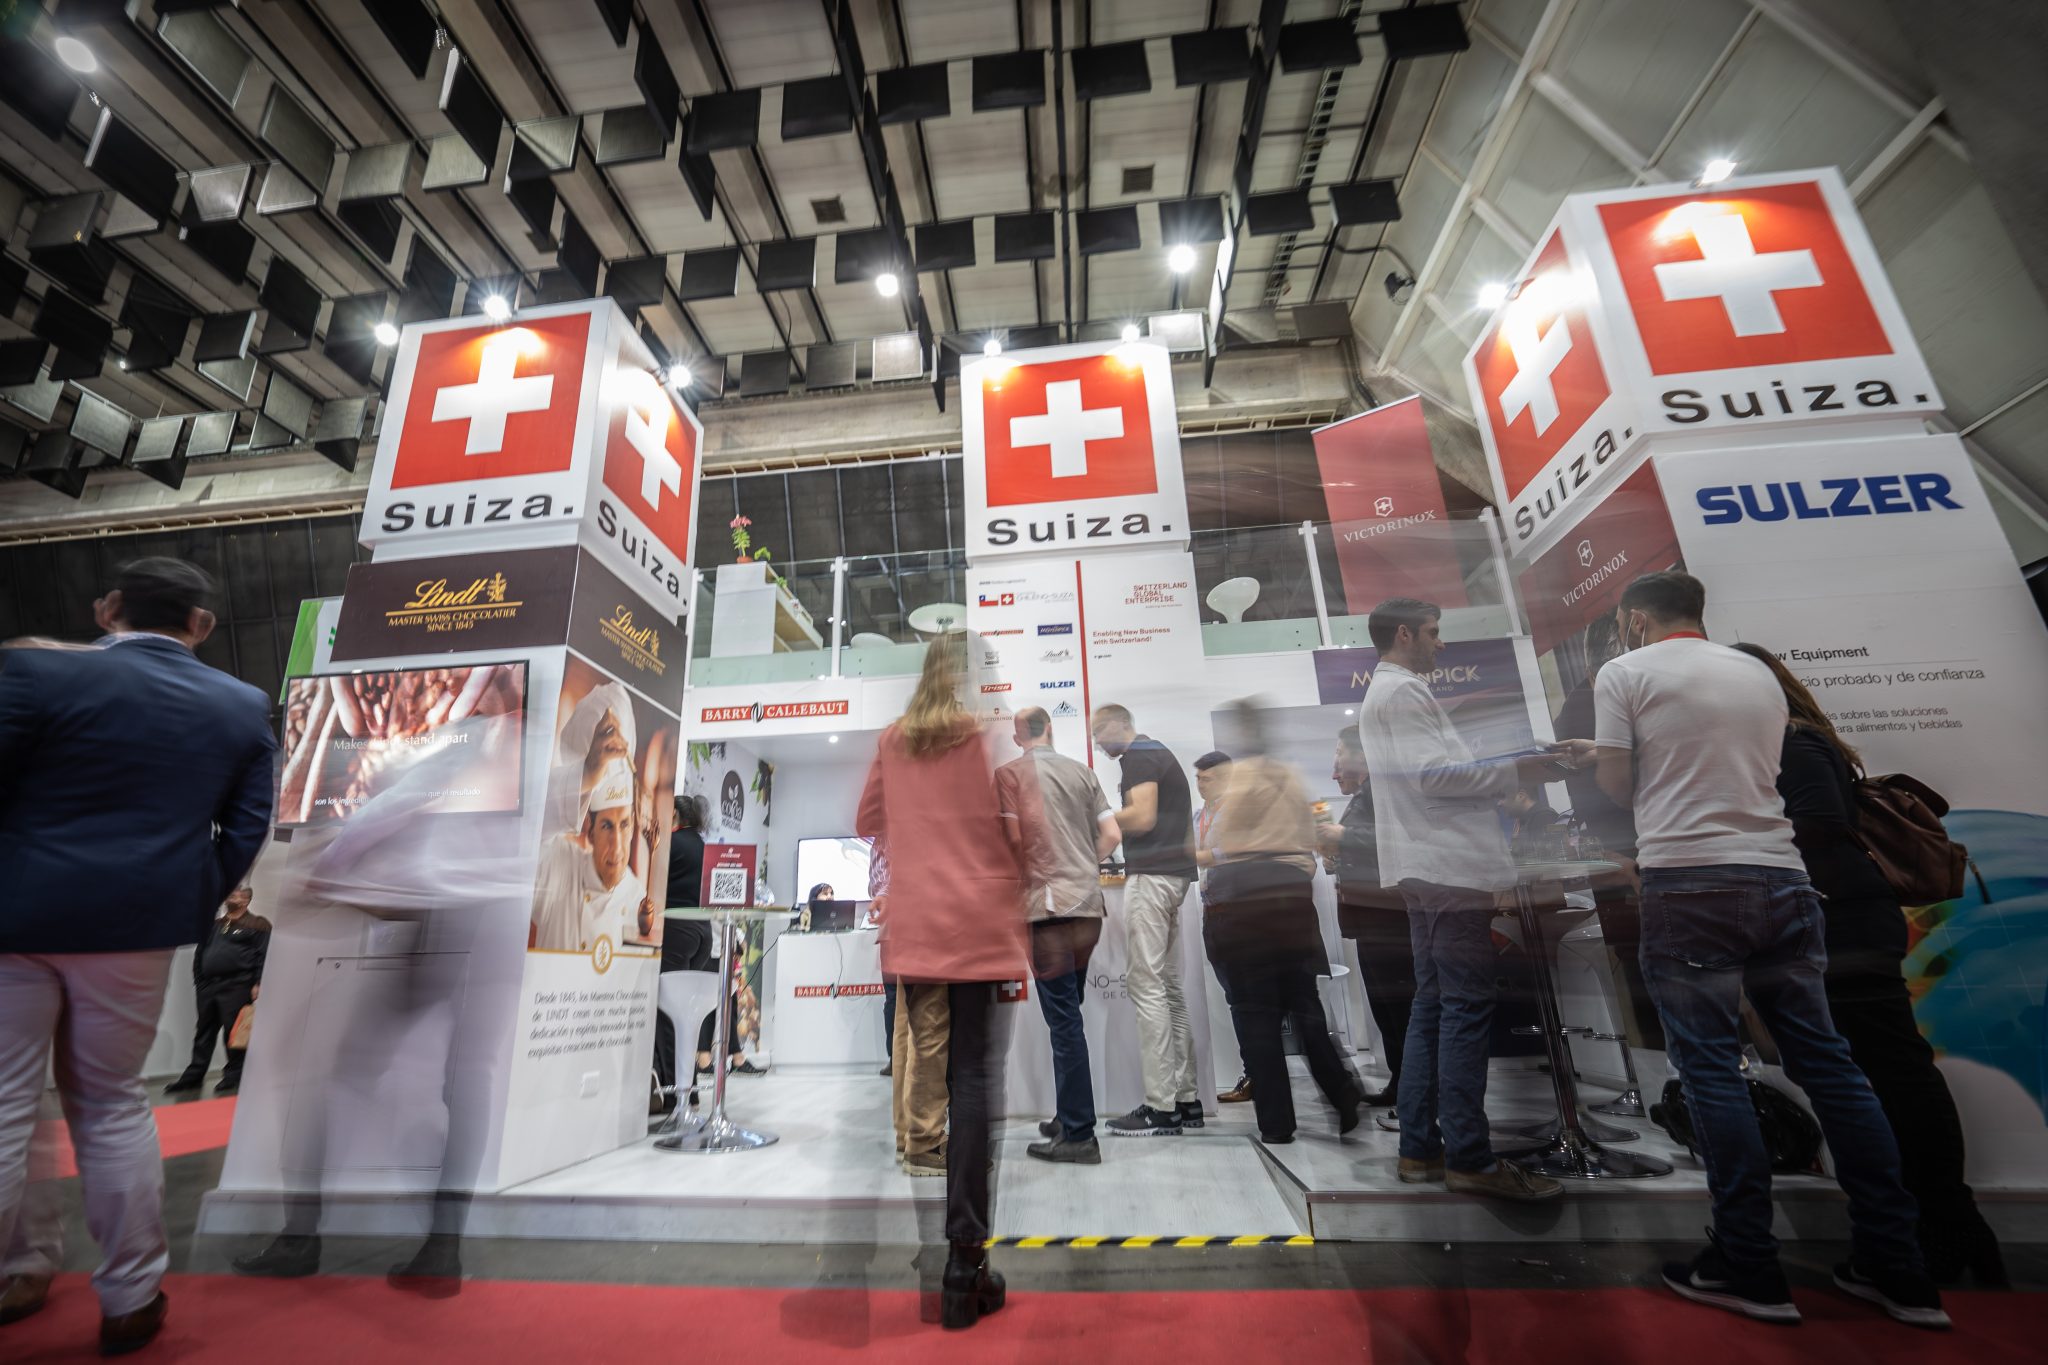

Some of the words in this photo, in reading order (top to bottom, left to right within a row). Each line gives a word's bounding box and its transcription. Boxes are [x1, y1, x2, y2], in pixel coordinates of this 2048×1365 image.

[1661, 379, 1929, 424] Suiza.
[1515, 423, 1633, 541] Suiza.
[1695, 473, 1965, 525] SULZER
[381, 492, 574, 533] Suiza.
[987, 512, 1172, 546] Suiza.
[1343, 509, 1437, 543] VICTORINOX
[597, 499, 687, 606] Suiza.
[1133, 581, 1188, 592] SWITZERLAND
[1561, 550, 1630, 608] VICTORINOX
[404, 578, 489, 609] Lindt
[1124, 595, 1175, 605] ENTERPRISE
[388, 616, 423, 627] MASTER
[425, 613, 451, 623] SWISS
[452, 607, 517, 621] CHOCOLATIER
[427, 622, 453, 632] SINCE
[455, 620, 474, 631] 1845
[610, 604, 652, 647] Lindt
[1092, 630, 1123, 638] Enabling
[1139, 626, 1171, 635] Business
[1093, 638, 1109, 646] with
[1109, 636, 1153, 645] Switzerland!
[1790, 646, 1870, 662] Equipment
[1039, 680, 1076, 690] SULZER
[1351, 664, 1480, 689] MNPICK
[1799, 676, 1820, 688] cio
[1823, 673, 1882, 688] probado
[1884, 674, 1892, 686] y
[1896, 671, 1915, 682] de
[1918, 668, 1985, 682] confianza
[705, 707, 750, 721] BARRY
[766, 701, 846, 717] CALLEBAUT
[1825, 711, 1838, 721] ás
[1840, 709, 1871, 720] sobre
[1873, 708, 1889, 718] las
[1890, 707, 1948, 718] soluciones
[1856, 721, 1908, 733] alimentos
[1907, 721, 1916, 732] y
[1918, 719, 1963, 730] bebidas
[334, 739, 367, 751] Makes
[405, 733, 434, 746] stand
[797, 987, 828, 997] BARRY
[840, 984, 885, 995] CALLEBA
[1103, 990, 1116, 999] DE
